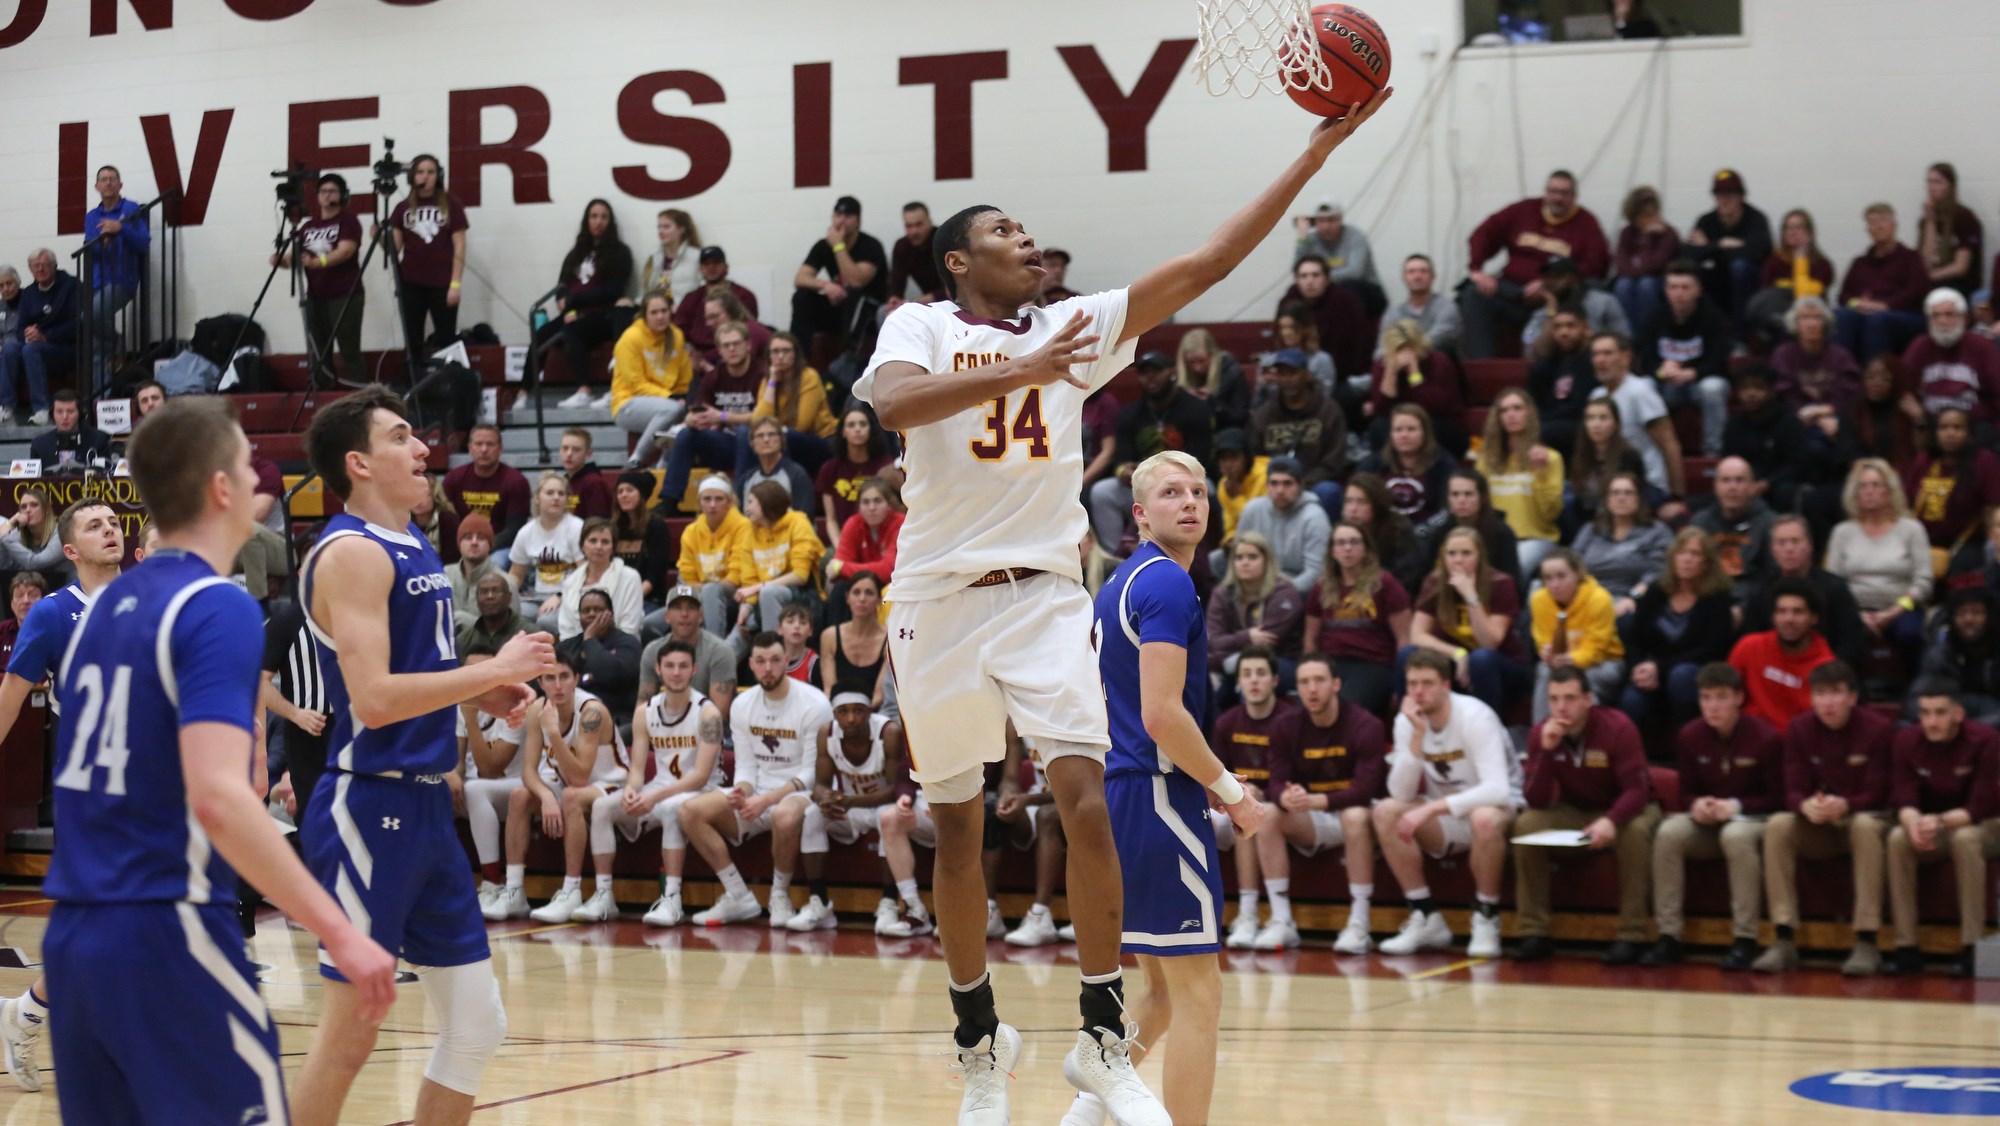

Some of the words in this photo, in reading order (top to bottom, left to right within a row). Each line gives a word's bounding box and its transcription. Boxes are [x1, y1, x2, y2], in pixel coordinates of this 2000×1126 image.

[1323, 18, 1383, 76] Wilson
[57, 37, 1199, 236] IVERSITY
[969, 385, 1051, 462] 34
[54, 663, 133, 796] 24
[650, 735, 698, 749] CONCORDIA
[669, 753, 683, 780] 4
